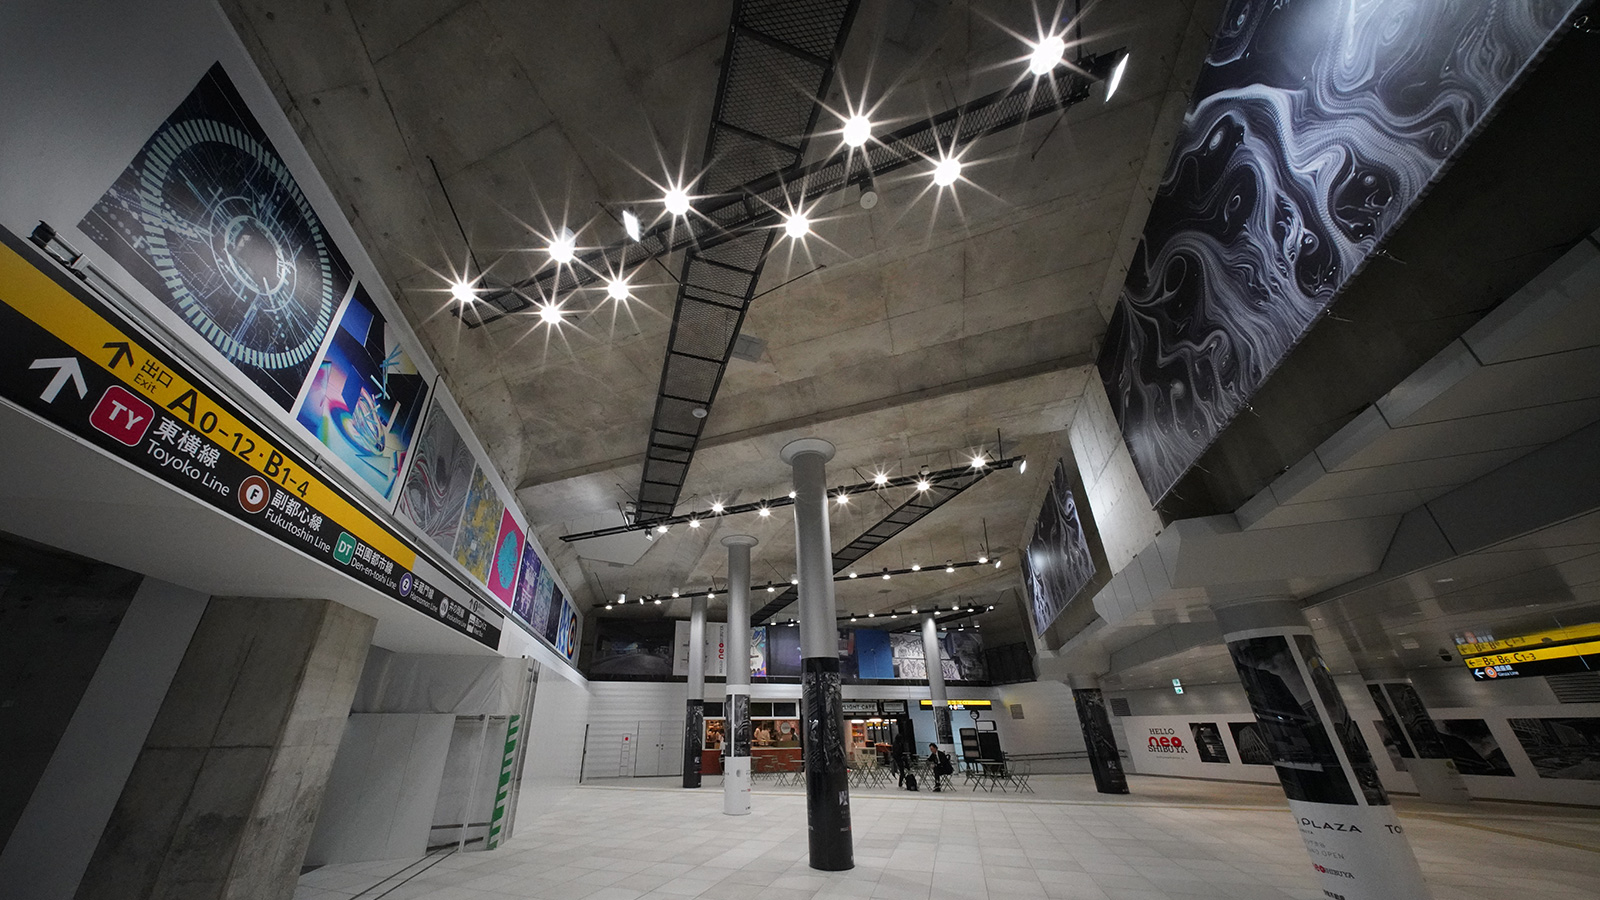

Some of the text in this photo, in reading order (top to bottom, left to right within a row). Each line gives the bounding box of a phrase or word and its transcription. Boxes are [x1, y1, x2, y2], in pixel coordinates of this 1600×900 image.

[133, 373, 157, 394] Exit
[141, 359, 174, 389] 出口
[108, 399, 144, 431] TY
[153, 416, 221, 469] 東横線
[147, 438, 230, 497] Toyoko Line
[249, 488, 260, 500] F
[270, 489, 323, 532] 副都心線
[264, 508, 331, 553] Fukutoshin Line
[337, 540, 353, 556] DT
[355, 542, 394, 575] 田園都市線
[350, 557, 398, 590] Den-en-toshi Line
[1147, 745, 1189, 754] SHIBUYA
[1148, 736, 1182, 747] neo
[1300, 817, 1363, 833] PLAZA
